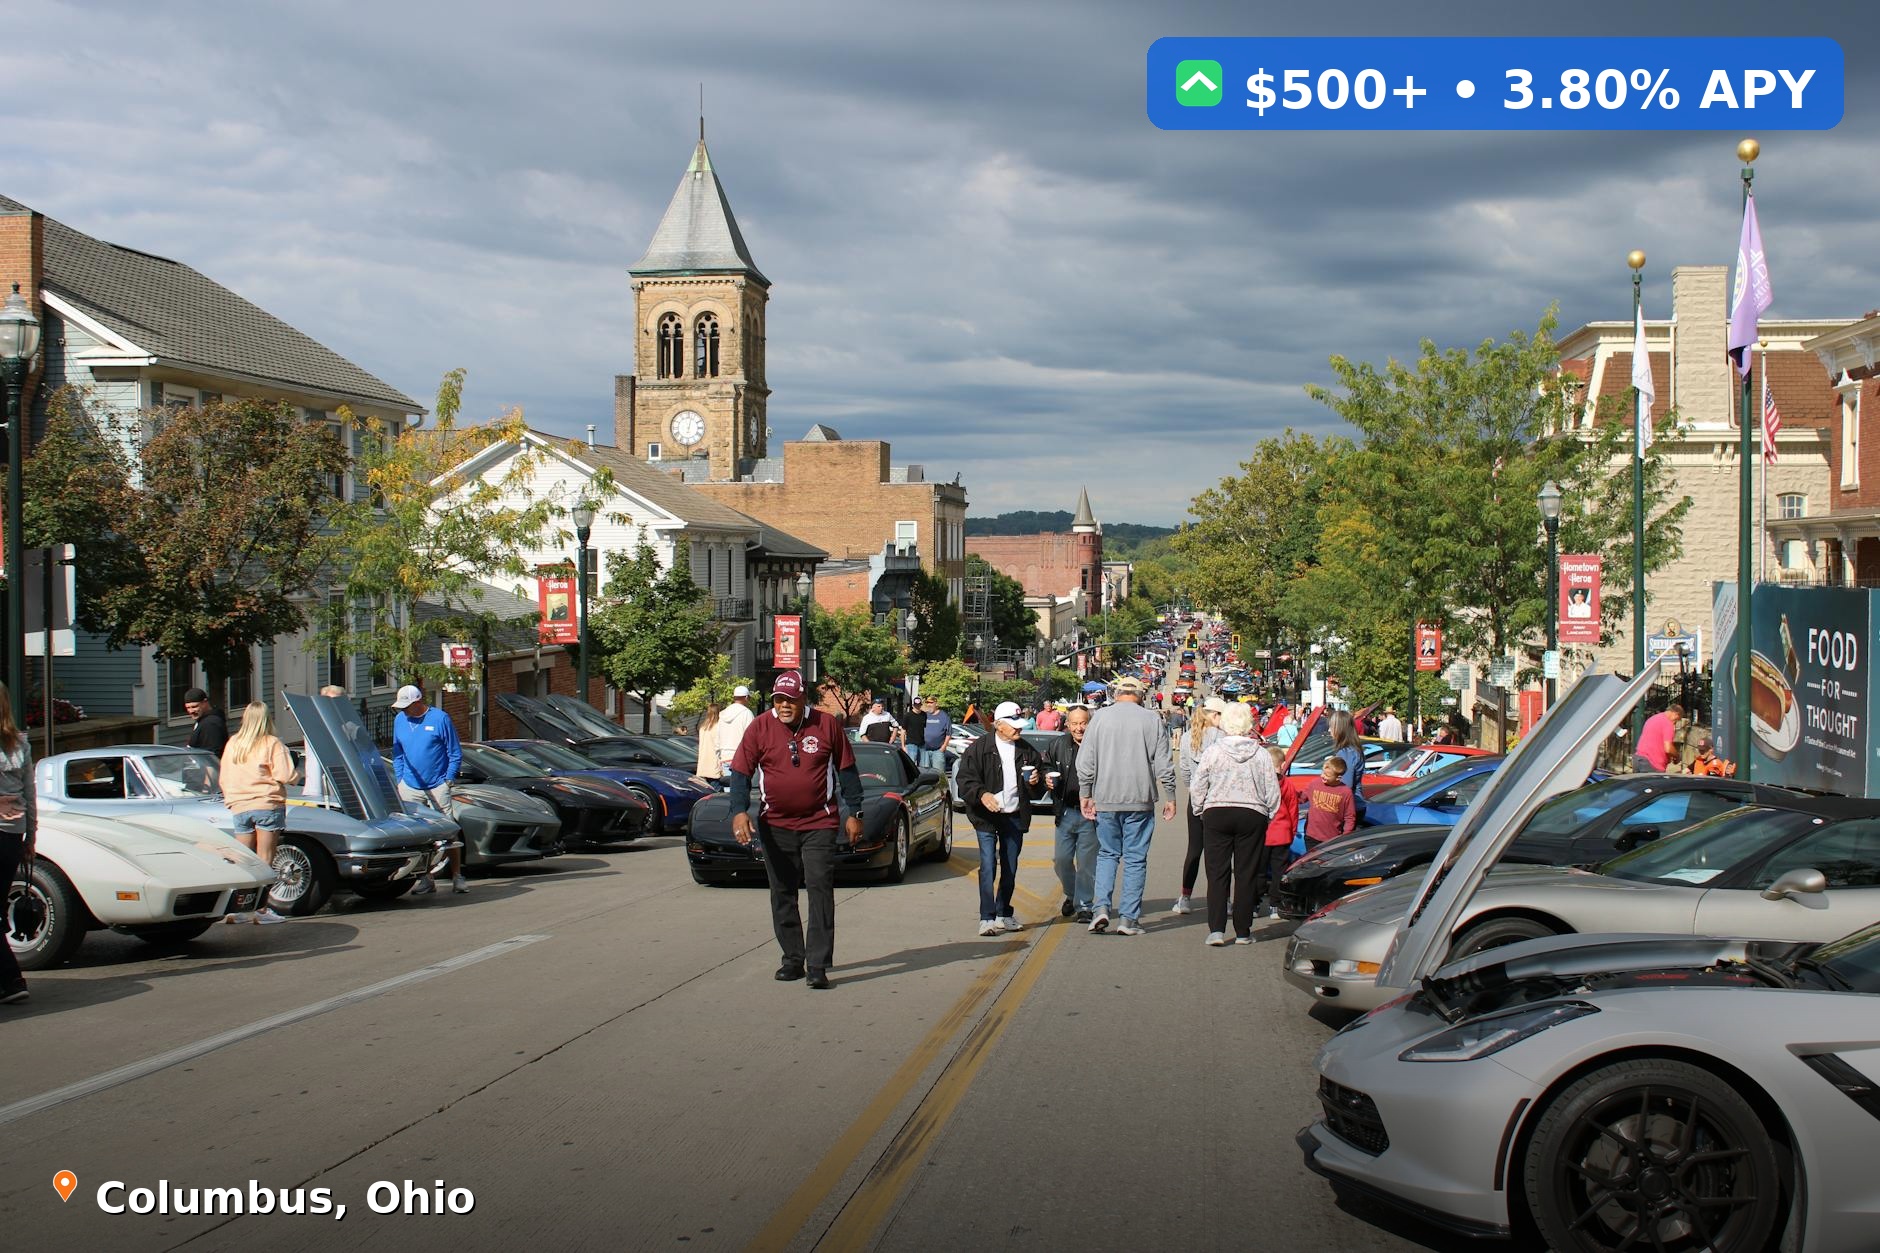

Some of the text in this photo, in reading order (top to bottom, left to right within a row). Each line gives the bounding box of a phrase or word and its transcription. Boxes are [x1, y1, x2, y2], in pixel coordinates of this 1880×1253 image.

[1560, 562, 1599, 575] Hometown
[1808, 628, 1857, 671] FOOD
[1821, 678, 1840, 700] FOR
[1806, 705, 1857, 739] THOUGHT
